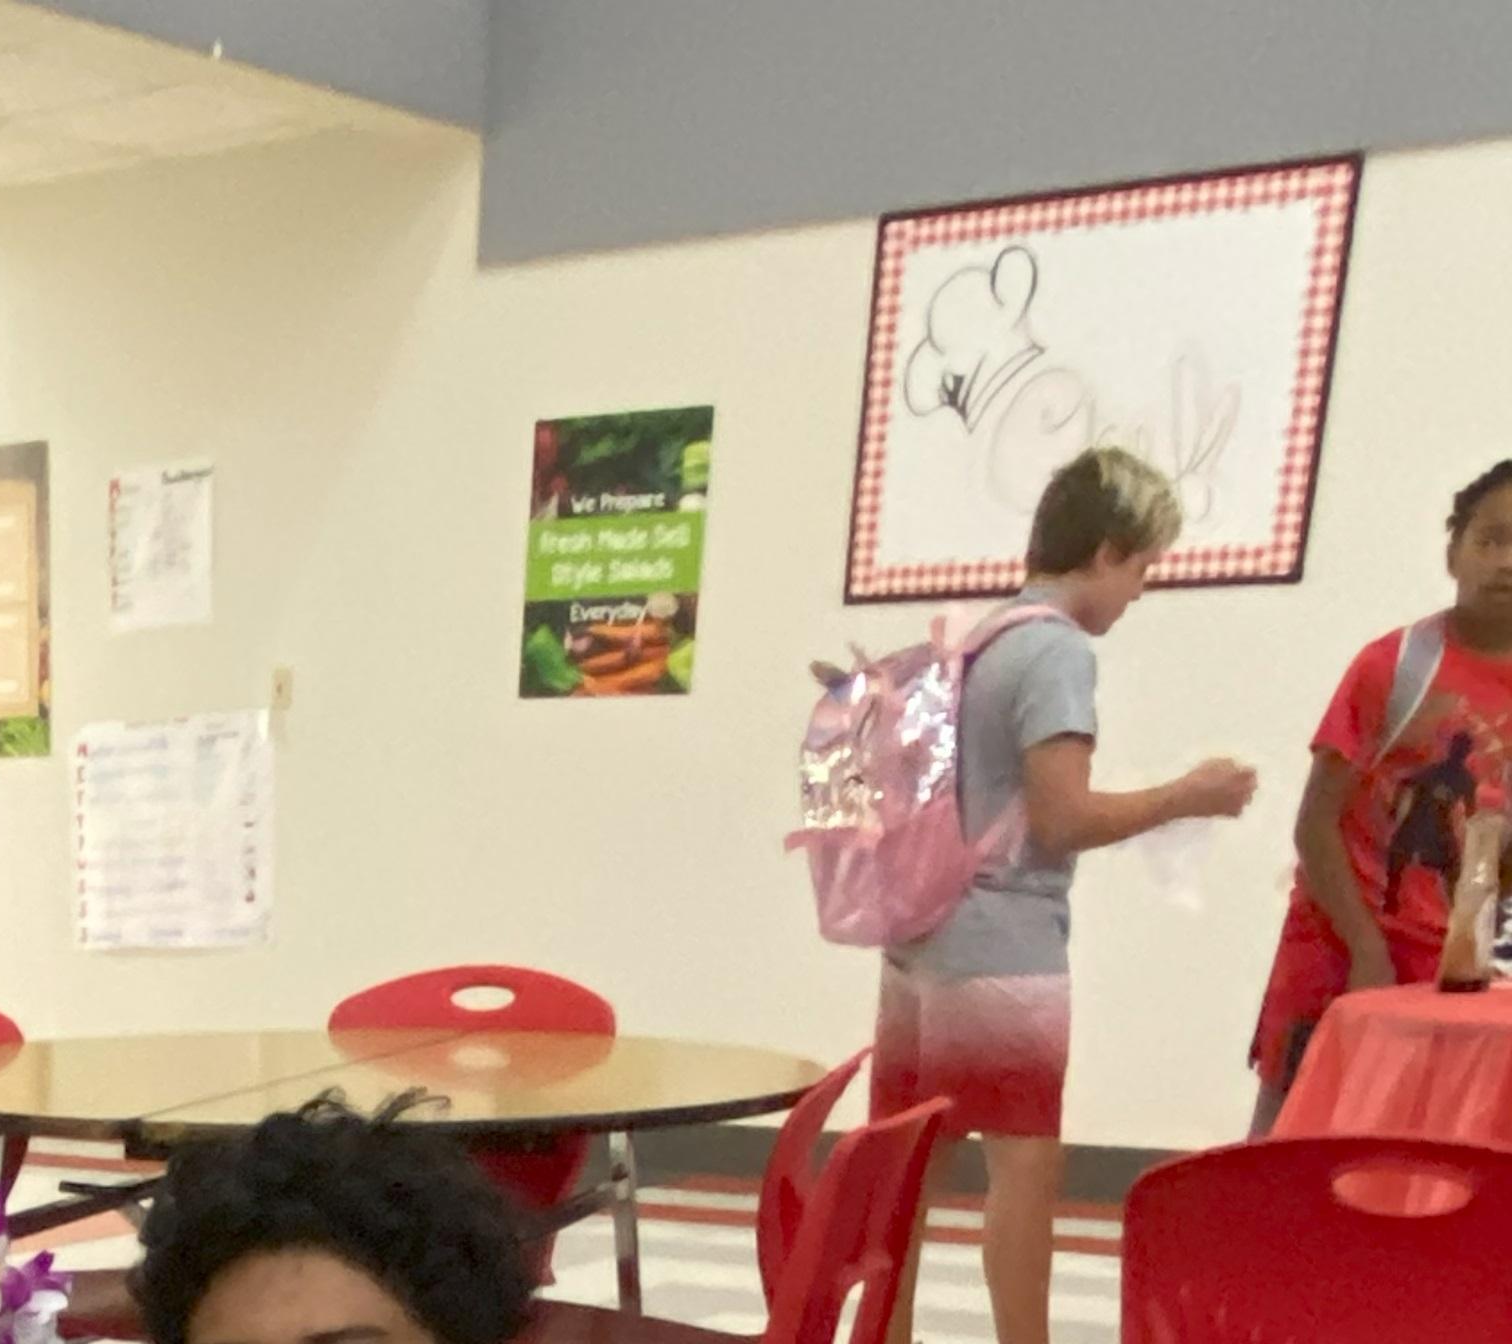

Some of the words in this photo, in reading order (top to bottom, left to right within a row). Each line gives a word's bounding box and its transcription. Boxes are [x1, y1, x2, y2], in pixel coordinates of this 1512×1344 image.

[571, 494, 597, 514] We
[599, 492, 666, 516] Prepare
[539, 530, 592, 554] Fresh
[598, 527, 648, 551] Made
[653, 522, 691, 549] Deli
[551, 561, 603, 591] Style
[607, 556, 675, 583] Salads
[569, 601, 646, 626] Everyday
